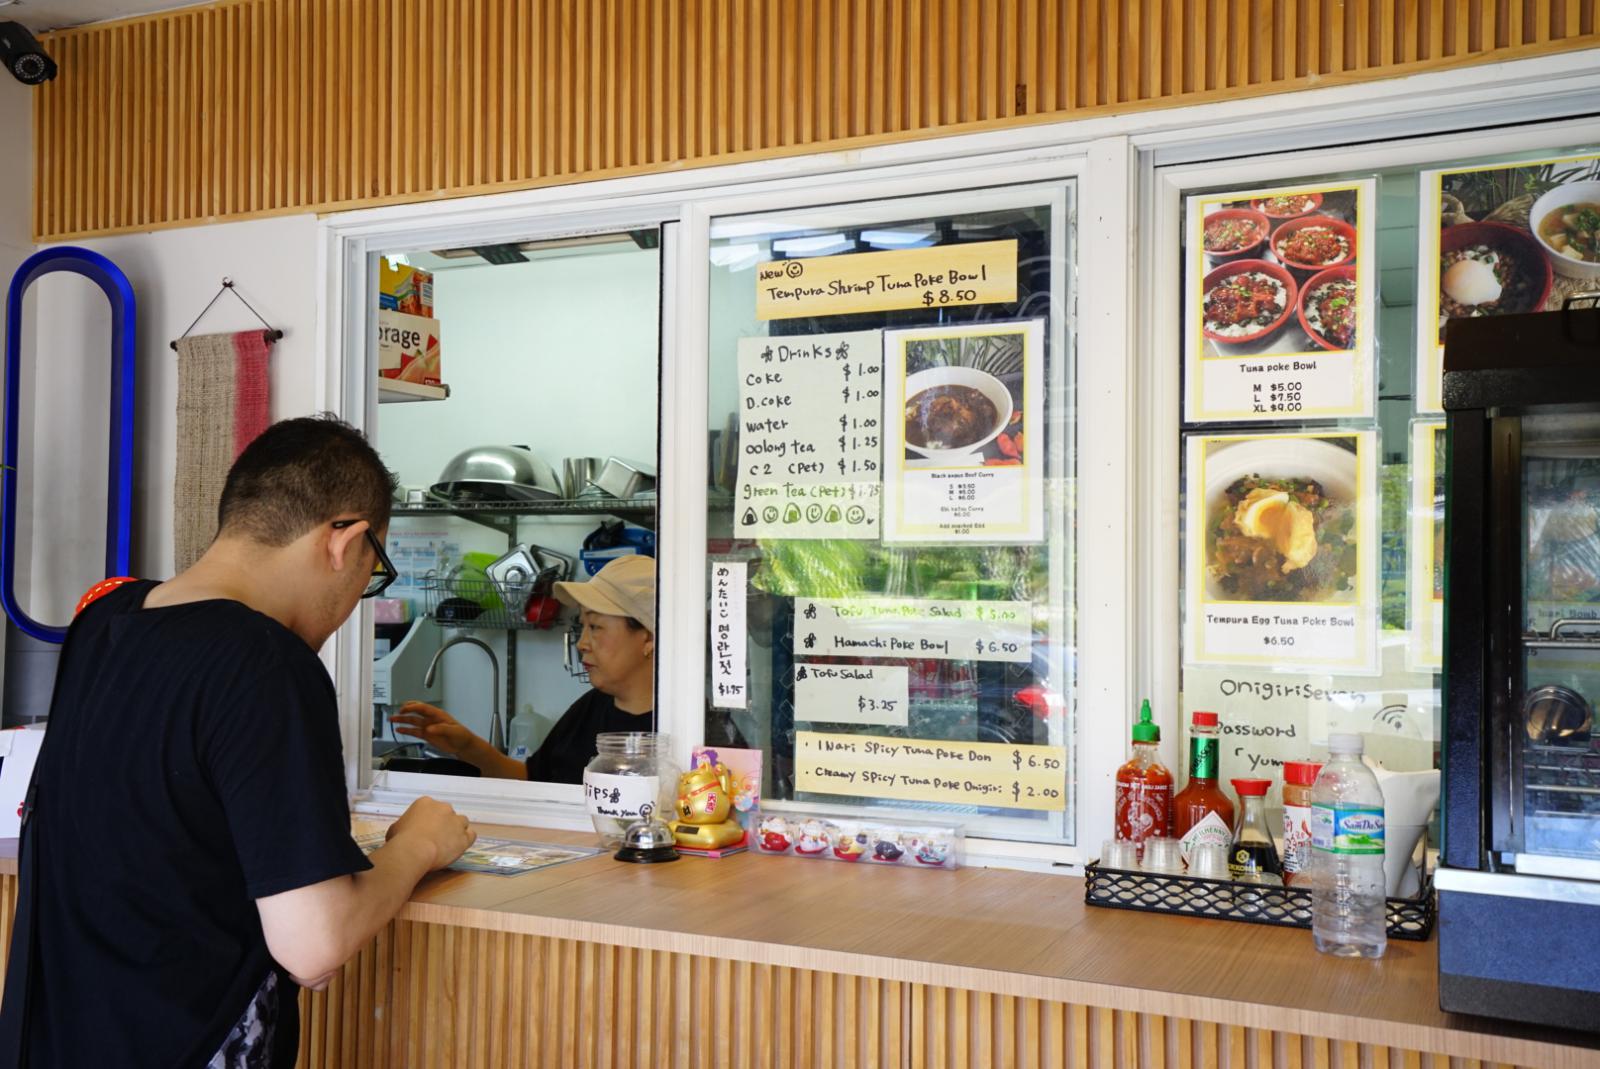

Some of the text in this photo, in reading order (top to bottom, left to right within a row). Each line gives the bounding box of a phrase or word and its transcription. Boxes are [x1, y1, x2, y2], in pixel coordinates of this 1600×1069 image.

[760, 269, 783, 281] New
[766, 265, 987, 300] Tempura Shrimp Tuna Poke Bowl
[778, 343, 832, 362] Drinks
[1240, 361, 1317, 373] Tuna poke Bowl
[746, 373, 782, 386] Coke
[1253, 382, 1302, 392] M $5.00
[1254, 392, 1301, 402] L $7.50
[1253, 402, 1302, 412] XL $9.00
[791, 440, 815, 454] tea
[743, 484, 778, 499] green
[832, 606, 863, 618] Tofu
[929, 606, 962, 618] Salad
[1207, 614, 1355, 627] Tempura Egg Tuna Poke Bowl
[834, 635, 887, 648] Hamachi
[890, 636, 915, 650] Poke
[920, 638, 949, 654] Bowl
[1263, 636, 1295, 646] $6.50
[810, 668, 873, 680] Tofu Salad
[718, 682, 743, 696] $1.75
[858, 696, 897, 712] $3.25
[902, 745, 934, 756] Tuna
[968, 750, 992, 762] Don
[815, 767, 856, 783] Creamy
[900, 775, 931, 787] Tuna
[933, 777, 960, 790] Poke
[585, 782, 609, 800] Tips
[597, 806, 618, 816] Thank
